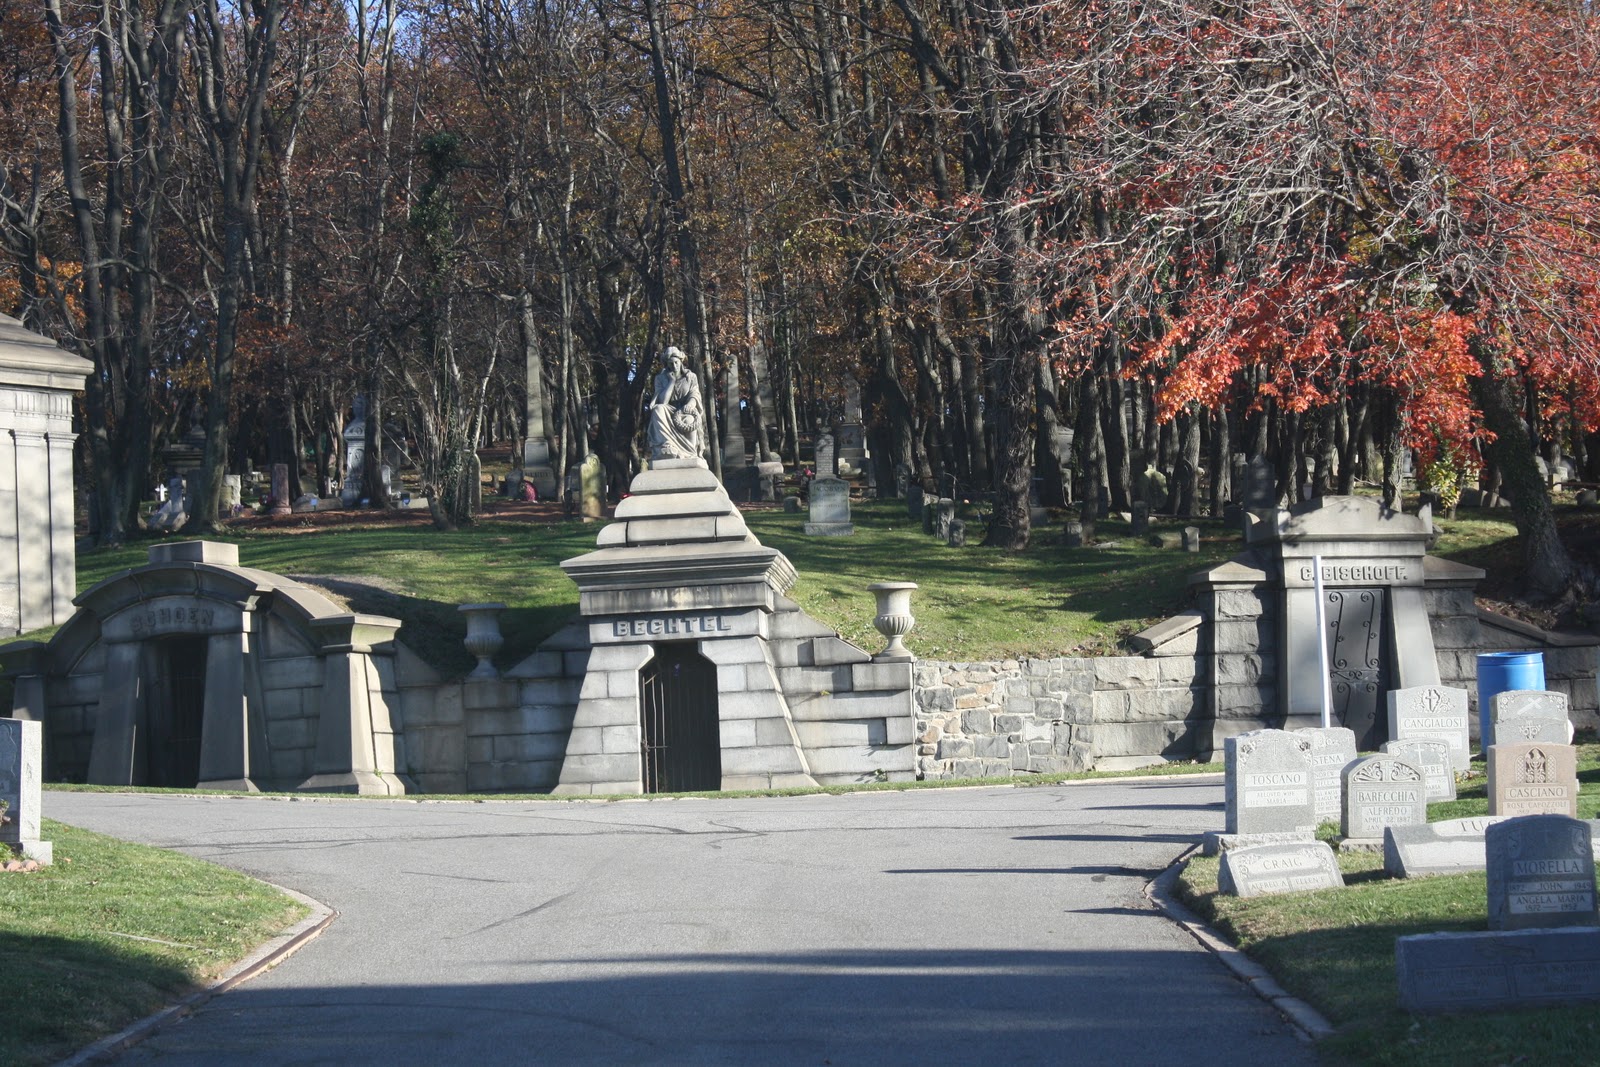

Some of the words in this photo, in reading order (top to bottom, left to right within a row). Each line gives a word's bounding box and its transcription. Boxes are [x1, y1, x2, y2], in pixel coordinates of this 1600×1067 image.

[130, 606, 214, 632] SCHOEN
[612, 615, 732, 637] BECHTEL
[1403, 717, 1463, 729] CANGIALOSI
[1313, 754, 1342, 764] STENA
[1251, 773, 1301, 786] TOSCANO
[1358, 791, 1416, 802] BARECCHIA
[1509, 787, 1564, 798] CASCIANO
[1368, 806, 1407, 815] ALFREDO
[1262, 857, 1303, 870] CRAIG
[1516, 860, 1581, 874] MORELLA
[1537, 882, 1564, 891] JOHN
[1574, 881, 1592, 890] 1949
[1516, 895, 1553, 905] ANGELA
[1557, 894, 1586, 903] MARIA
